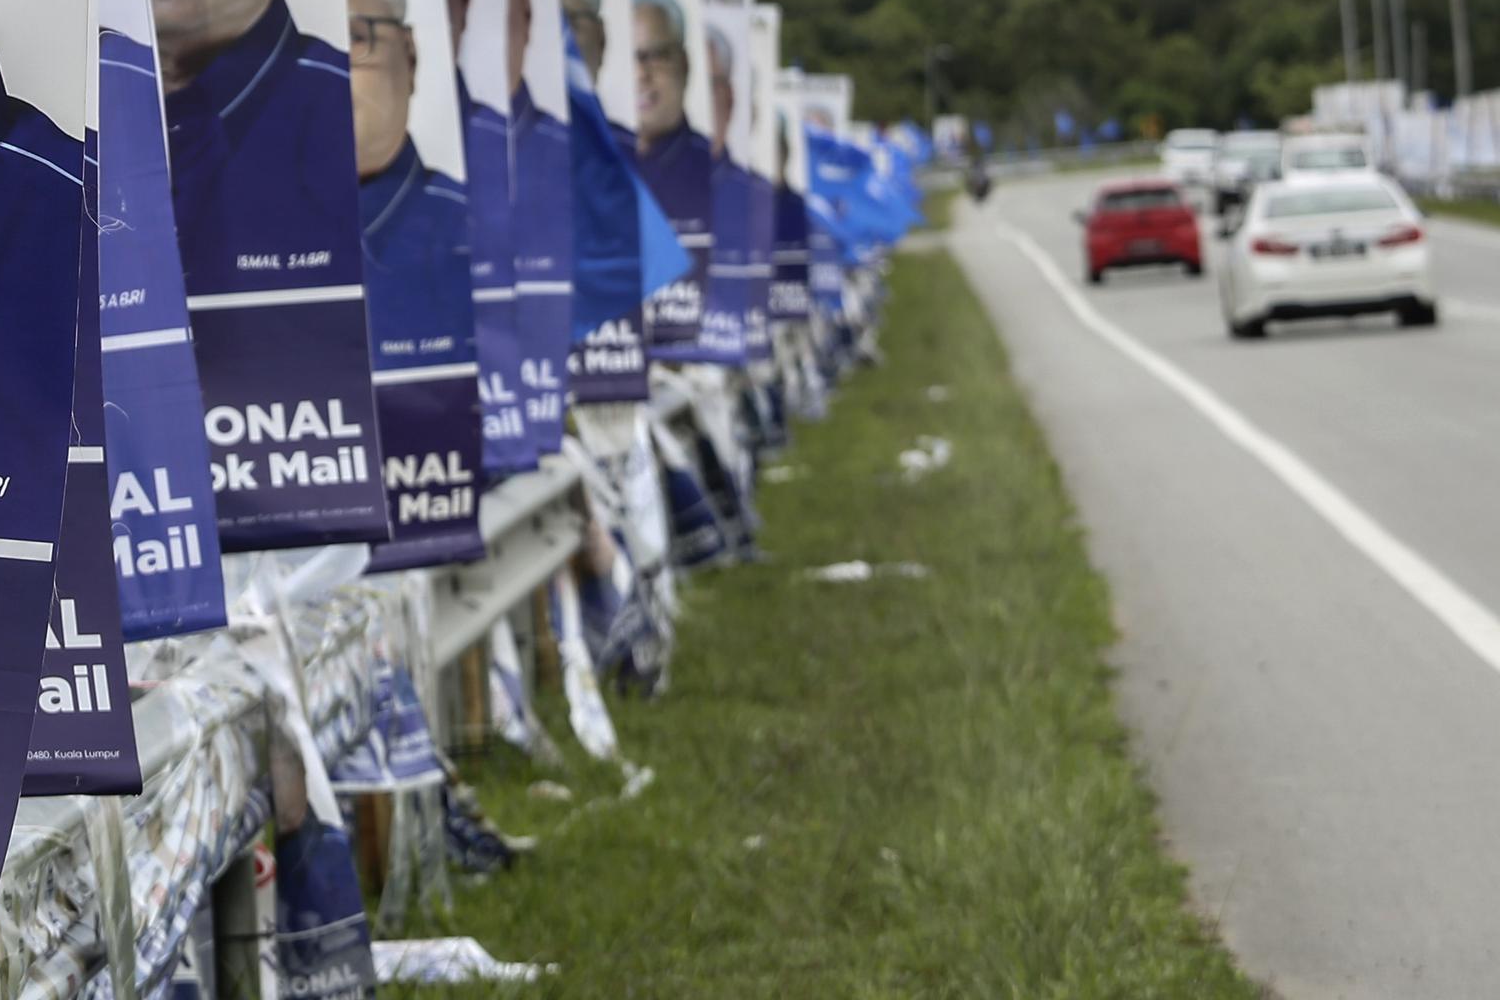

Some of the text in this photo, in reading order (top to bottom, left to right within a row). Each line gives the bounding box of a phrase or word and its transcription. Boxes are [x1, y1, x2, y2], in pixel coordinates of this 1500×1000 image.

[100, 288, 146, 311] SABRI
[204, 399, 362, 446] ONAL
[268, 446, 369, 488] Mail
[110, 468, 193, 519] AL
[400, 486, 474, 524] Mail
[54, 749, 83, 760] Kuala
[85, 749, 121, 761] Lumpur
